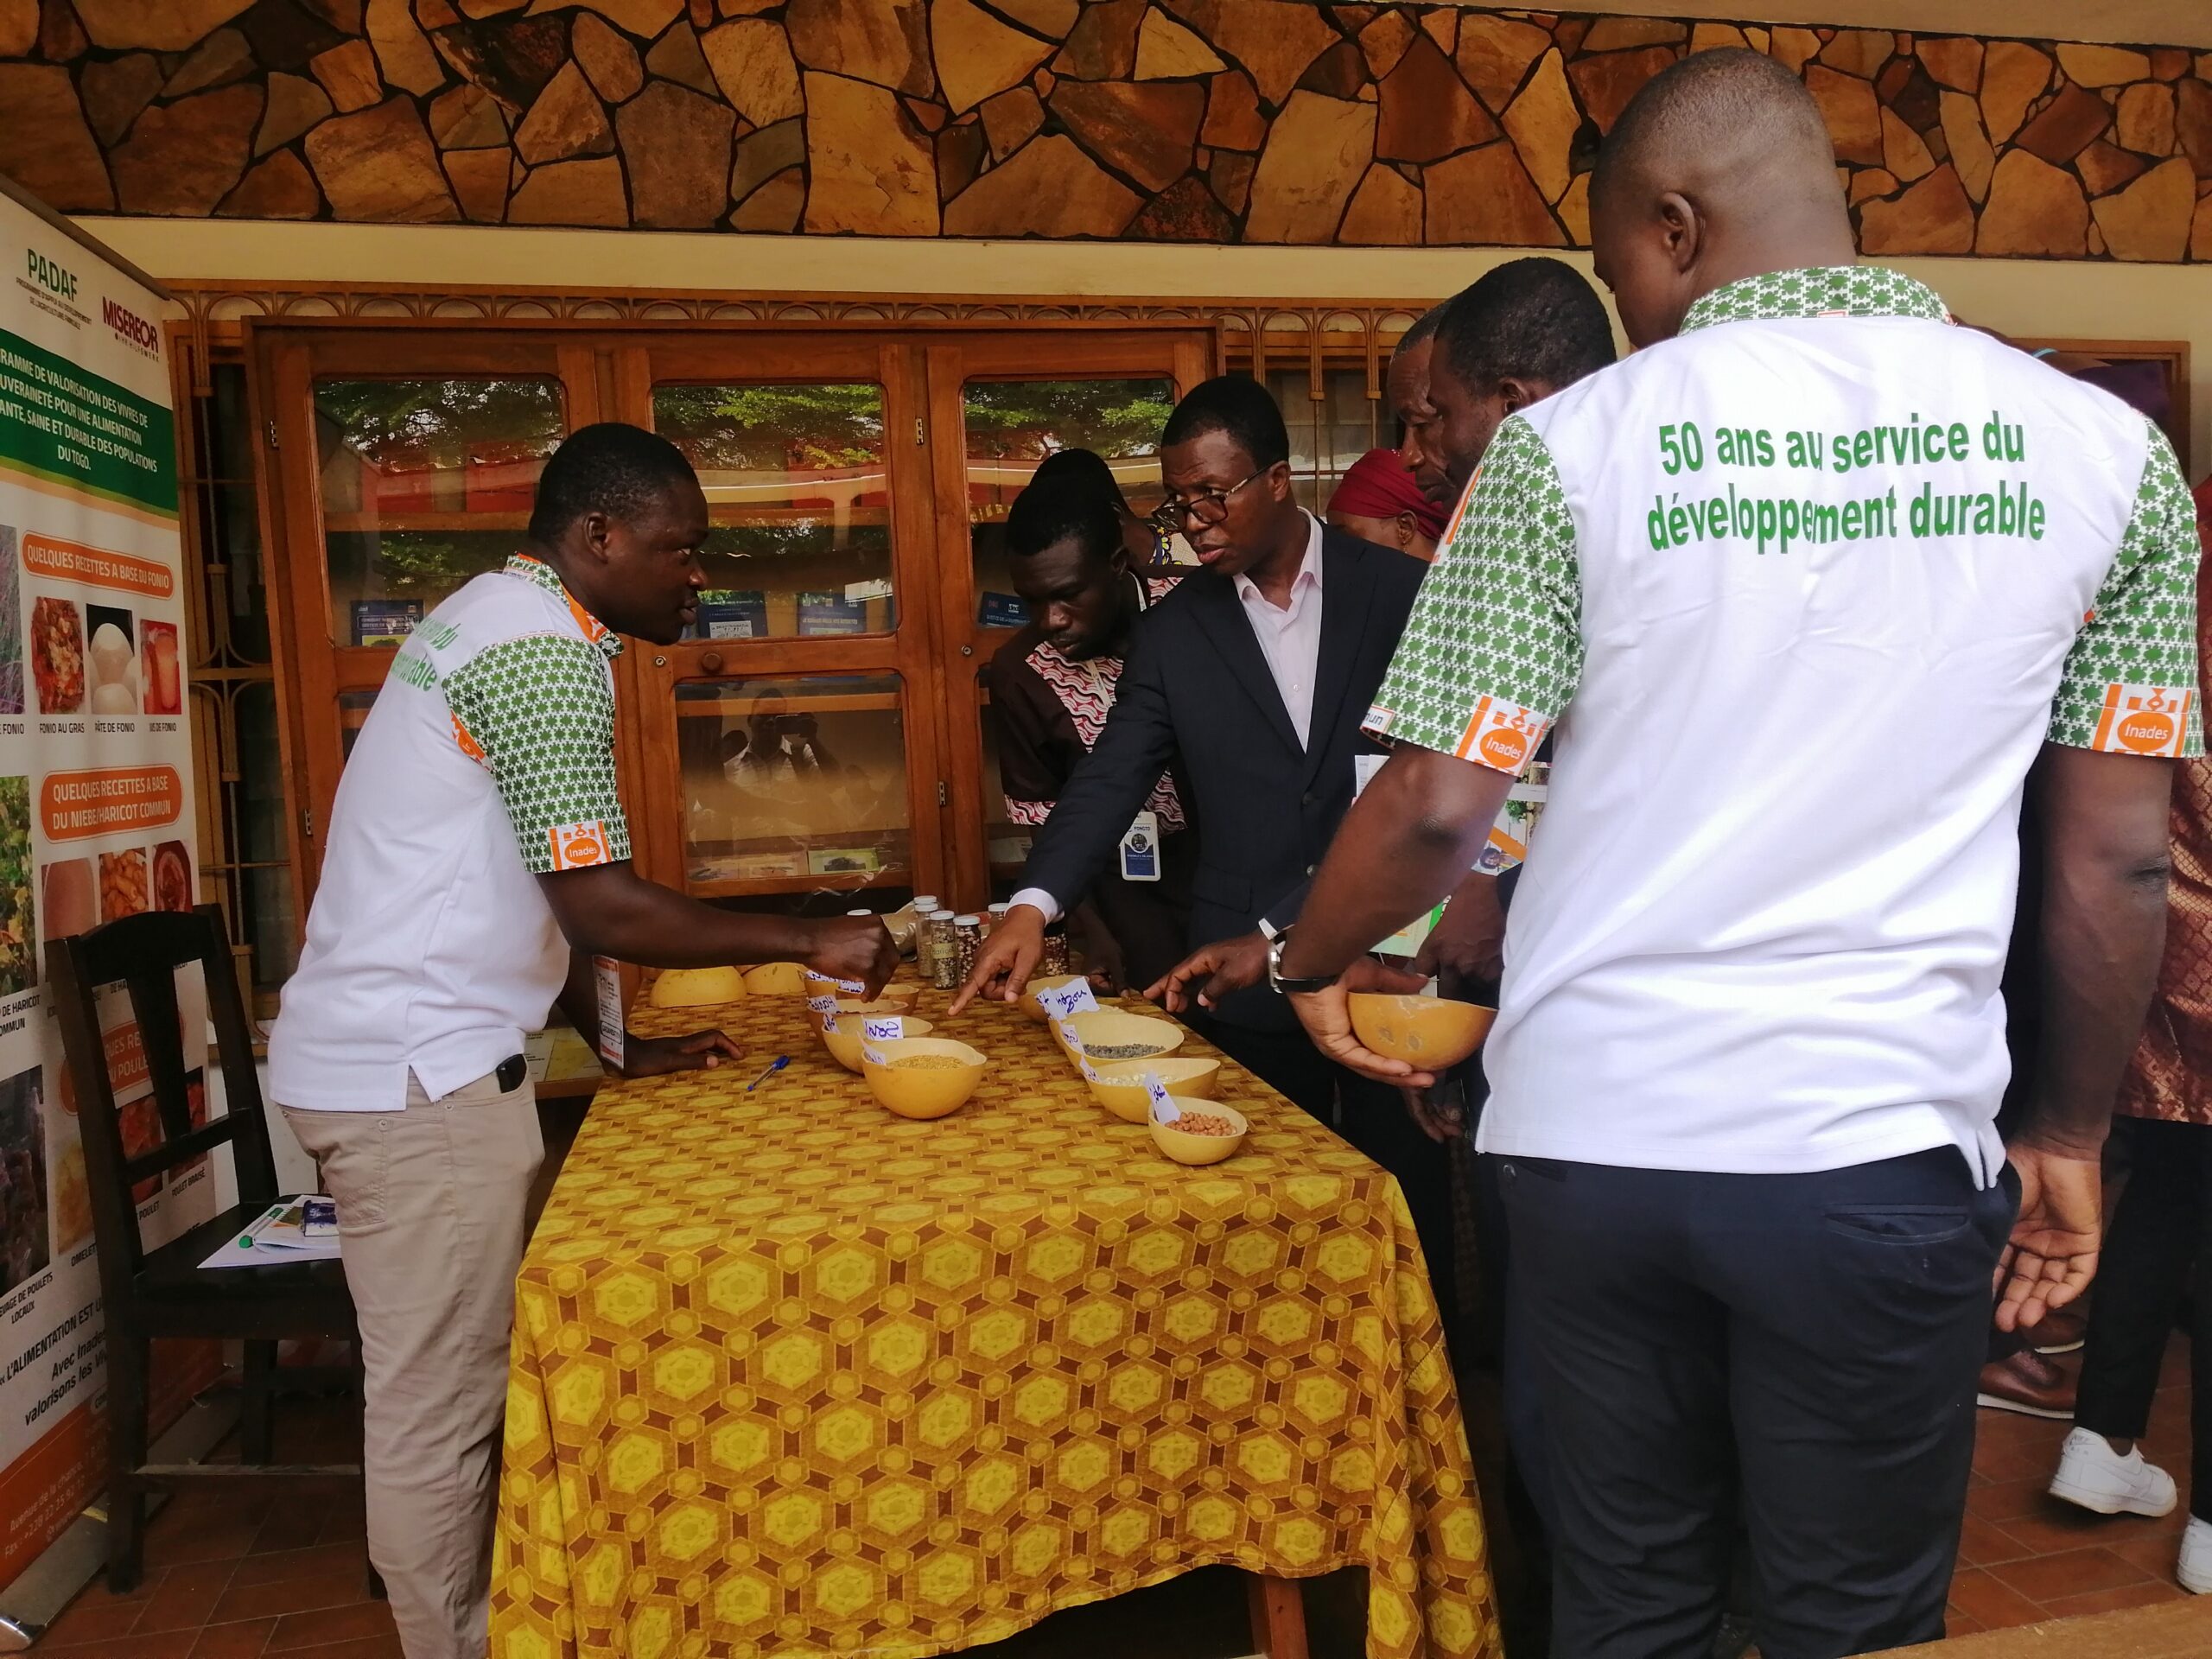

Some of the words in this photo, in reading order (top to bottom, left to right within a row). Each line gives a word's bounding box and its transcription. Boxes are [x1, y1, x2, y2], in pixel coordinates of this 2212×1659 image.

[28, 249, 78, 302] PADAF
[103, 296, 158, 354] MISEREOR
[35, 364, 46, 383] DE
[47, 369, 101, 407] VALORISATION
[102, 395, 117, 413] DES
[118, 401, 139, 423] VIVRES
[139, 413, 148, 428] DE
[54, 397, 77, 419] POUR
[77, 407, 91, 425] UNE
[92, 413, 142, 446] ALIMENTATION
[27, 409, 51, 432] SAINE
[52, 419, 63, 436] ET
[64, 423, 96, 449] DURABLE
[97, 437, 113, 455] DES
[113, 443, 157, 473] POPULATIONS
[58, 444, 71, 461] DU
[1659, 421, 1705, 475] 50
[1715, 425, 1776, 468] ans
[1785, 429, 1823, 471] au
[1833, 412, 1969, 474] service
[1982, 410, 2025, 462] du
[1647, 481, 1897, 555] développement
[1910, 480, 2046, 541] durable
[28, 544, 74, 569] QUELQUES
[75, 555, 111, 576] RECETTES
[119, 565, 139, 582] BASE
[139, 571, 147, 583] DU
[148, 574, 169, 589] FONIO
[3, 723, 25, 734] FONIO
[58, 722, 67, 733] AU
[68, 721, 85, 734] GRAS
[107, 722, 116, 733] DE
[117, 722, 135, 733] FONIO
[2125, 723, 2169, 740] Inades
[1486, 737, 1523, 760] Inades
[53, 780, 100, 802] QUELQUES
[101, 778, 145, 797] RECETTES
[152, 775, 168, 791] BASE
[53, 812, 68, 830] DU
[139, 799, 171, 819] COMMUN
[569, 846, 598, 858] Inades
[2, 1004, 11, 1017] DE
[12, 995, 41, 1014] HARICOT
[18, 1289, 27, 1304] DE
[27, 1271, 53, 1298] POULETS
[11, 1300, 35, 1324] LOCAUX
[7, 1314, 77, 1381] L'ALIMENTATION
[79, 1301, 93, 1325] EST
[51, 1352, 75, 1381] Avec
[25, 1374, 76, 1427] valorisons
[79, 1361, 92, 1382] les
